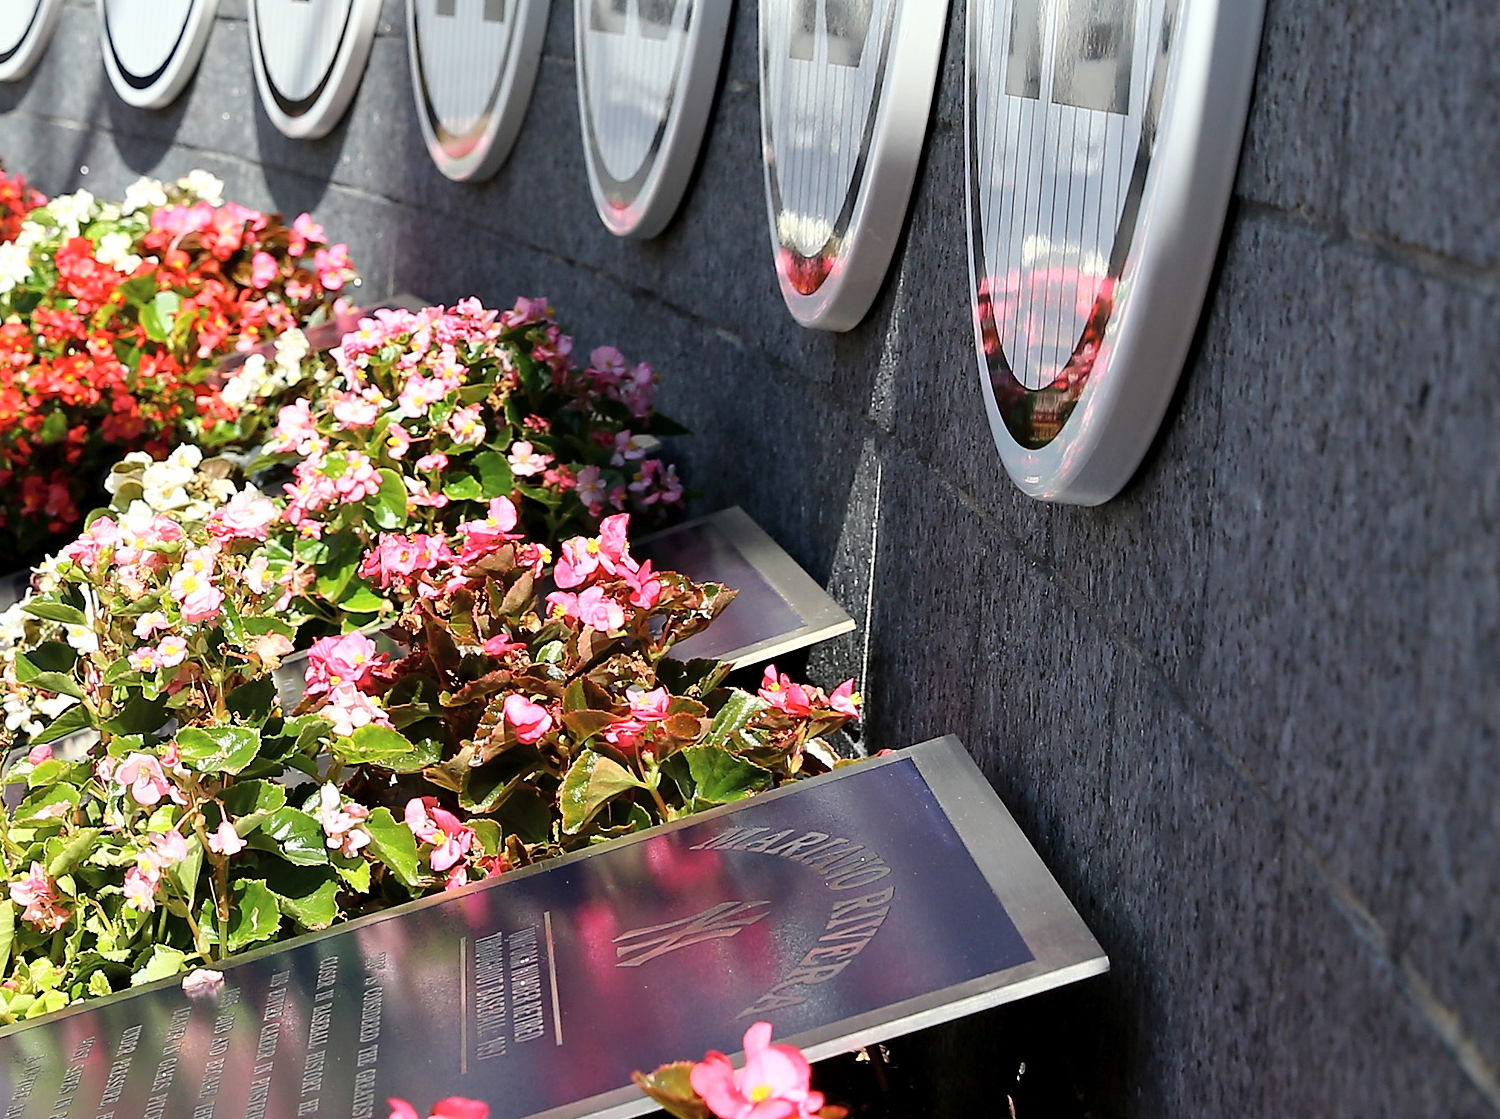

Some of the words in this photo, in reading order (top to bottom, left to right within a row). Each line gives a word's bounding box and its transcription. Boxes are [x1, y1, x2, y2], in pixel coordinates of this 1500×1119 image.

[690, 827, 891, 890] MARIANO
[475, 932, 503, 988] THROUGHOUT
[509, 926, 539, 969] UNIFORM
[735, 885, 895, 1020] RIVERA
[270, 970, 290, 987] HIS
[317, 955, 338, 989] CLOSER
[511, 964, 541, 1005] NUMBER
[264, 988, 286, 1021] ENTIRE
[315, 989, 334, 1002] IN
[166, 1006, 191, 1042] LEADER
[308, 1002, 333, 1050] BASEBALL
[360, 987, 383, 1042] CONSIDERED
[513, 1000, 544, 1043] RETIRED
[116, 1024, 143, 1057] UNDER
[163, 1043, 182, 1056] IN
[209, 1037, 229, 1056] AND
[256, 1023, 280, 1061] CAREER
[357, 1044, 378, 1067] THE
[151, 1057, 178, 1092] GAMES
[199, 1058, 225, 1098] BECAME
[254, 1061, 273, 1075] IN
[301, 1050, 326, 1097] HISTORY.
[298, 1098, 319, 1117] HE
